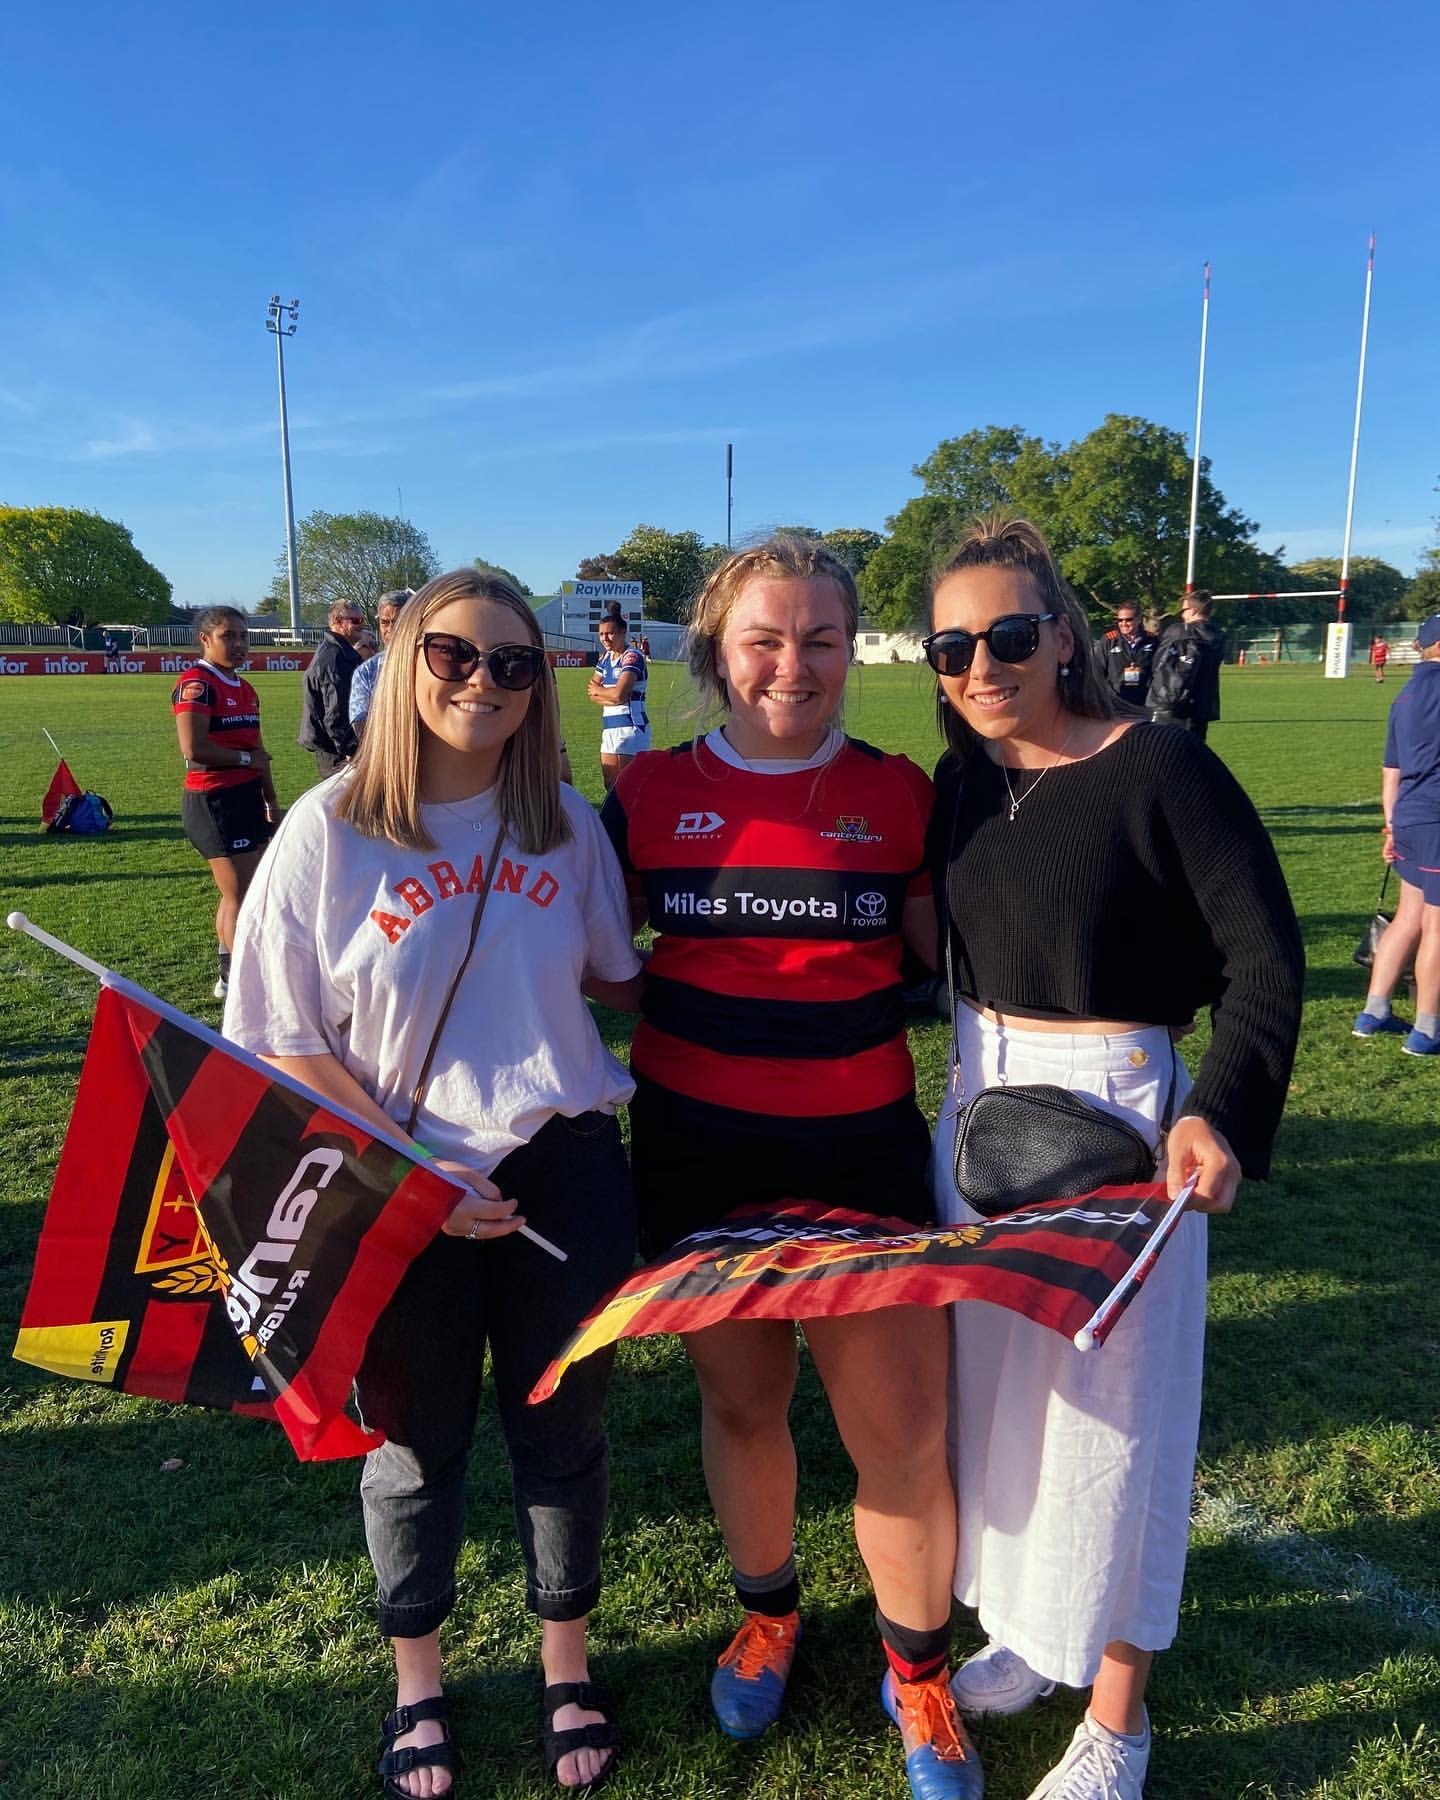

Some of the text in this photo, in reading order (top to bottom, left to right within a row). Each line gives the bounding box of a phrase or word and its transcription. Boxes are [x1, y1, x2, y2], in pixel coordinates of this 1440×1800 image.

[44, 656, 88, 673] infor
[266, 655, 301, 671] infor
[664, 892, 838, 920] Miles Toyota
[852, 918, 887, 926] TOYOTA
